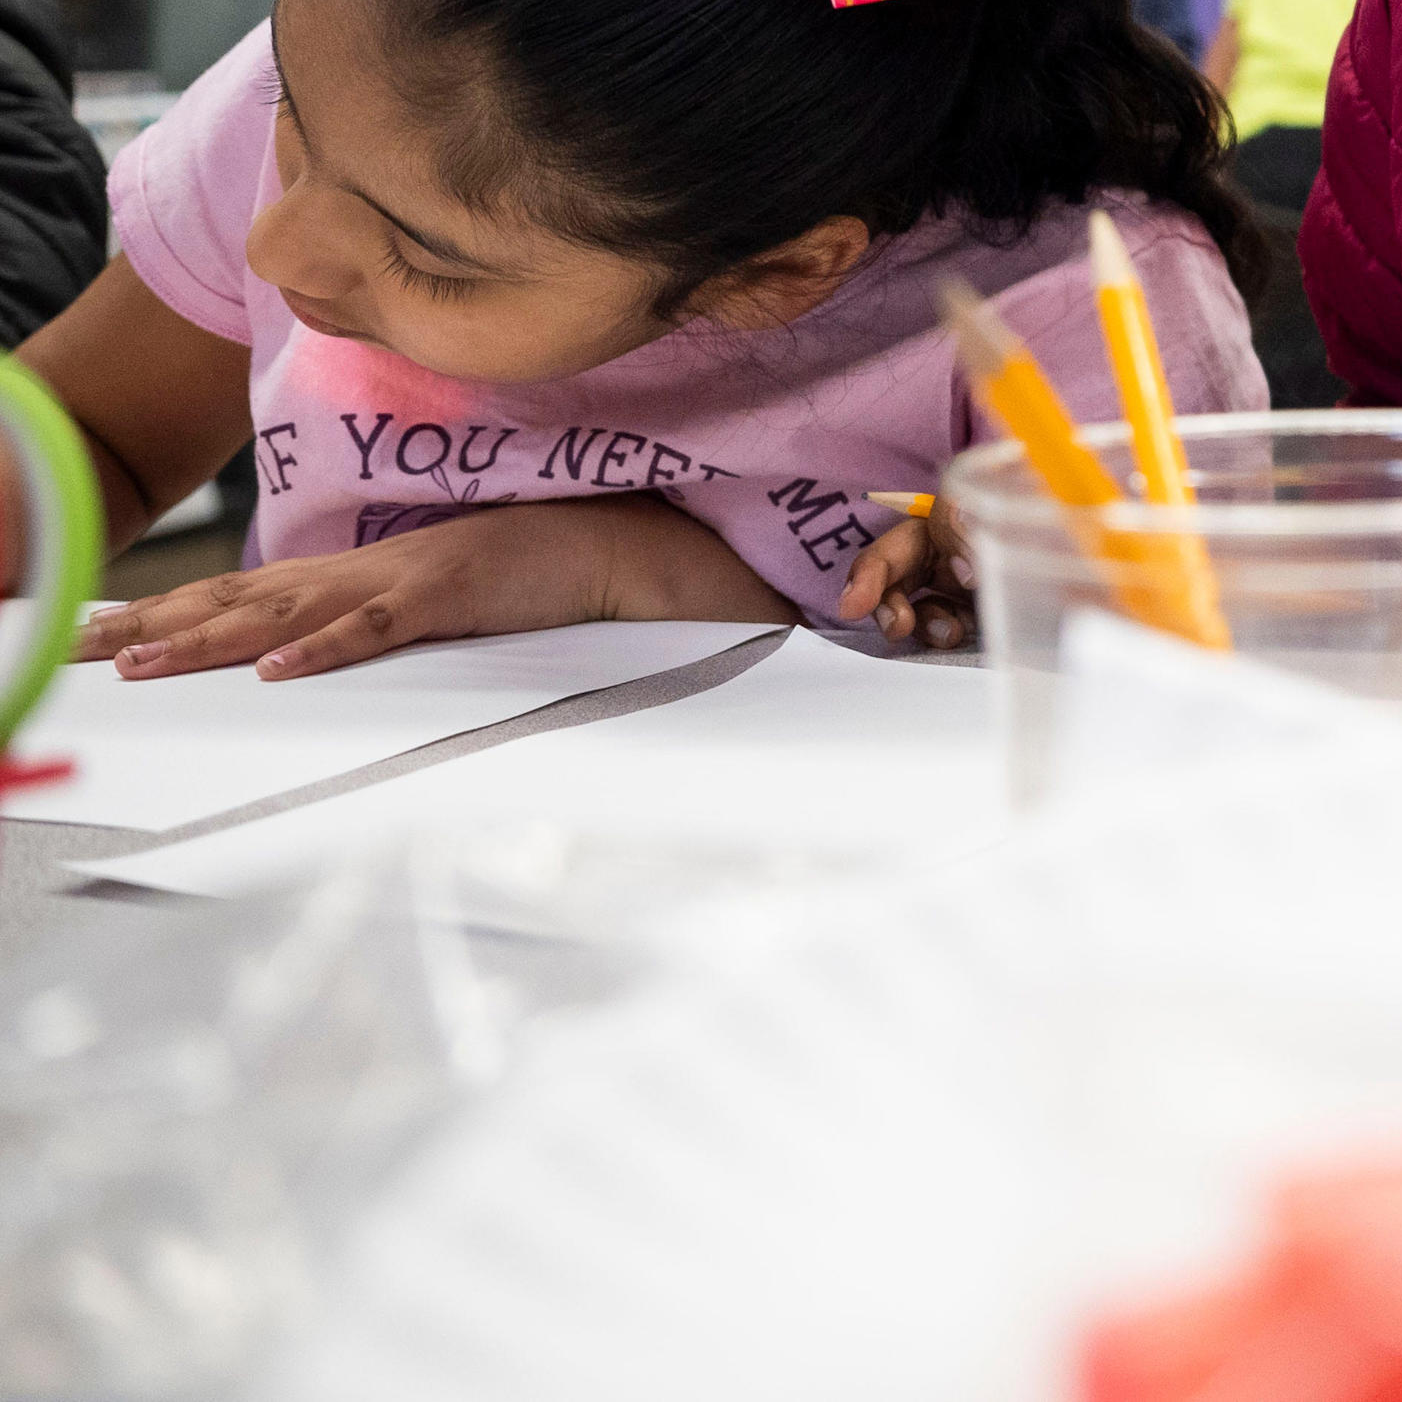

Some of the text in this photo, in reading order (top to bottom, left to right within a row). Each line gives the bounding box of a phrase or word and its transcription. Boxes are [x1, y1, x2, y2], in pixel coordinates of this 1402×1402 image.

[340, 412, 519, 480] YOU
[537, 426, 742, 488] NEE
[767, 477, 876, 572] ME
